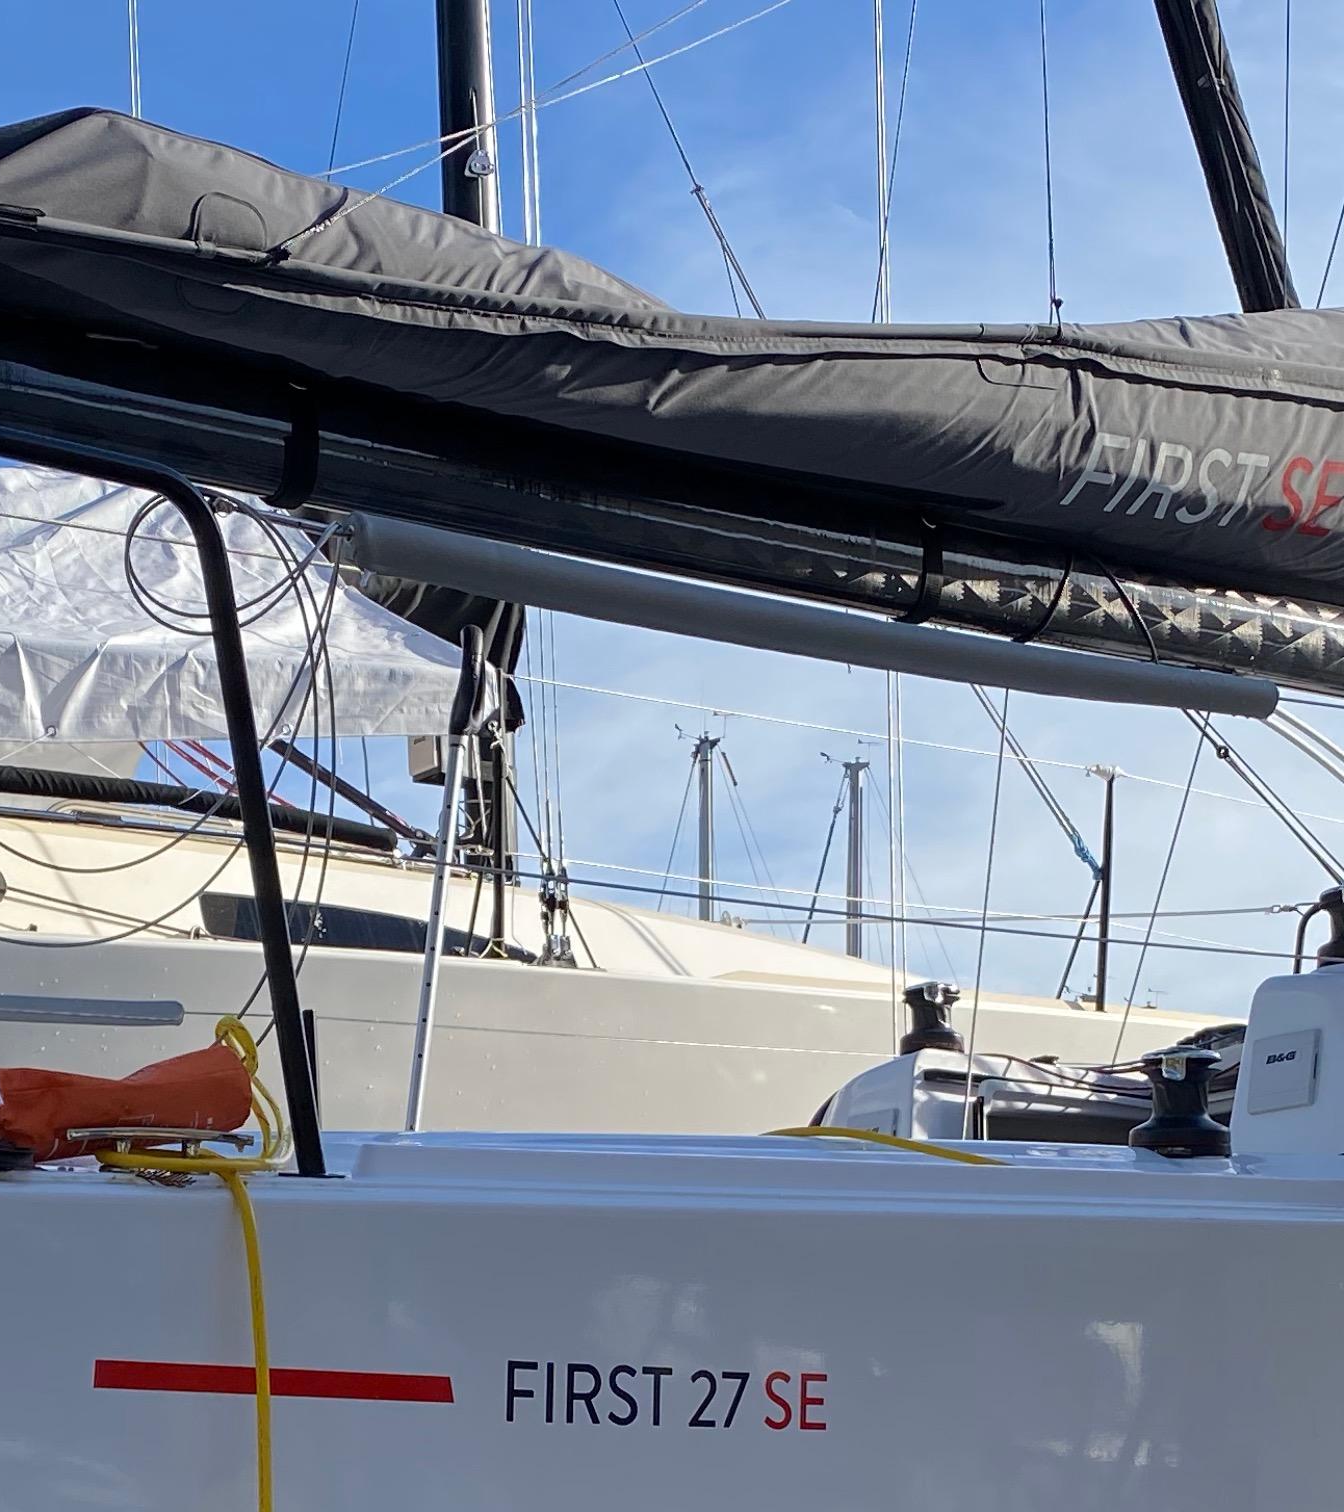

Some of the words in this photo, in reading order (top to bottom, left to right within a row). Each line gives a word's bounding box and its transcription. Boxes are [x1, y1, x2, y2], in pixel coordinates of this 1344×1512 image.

[1059, 432, 1270, 528] FIRST
[1266, 1050, 1297, 1065] B&G
[505, 1360, 673, 1426] FIRST
[688, 1369, 750, 1428] 27
[764, 1371, 828, 1431] SE
